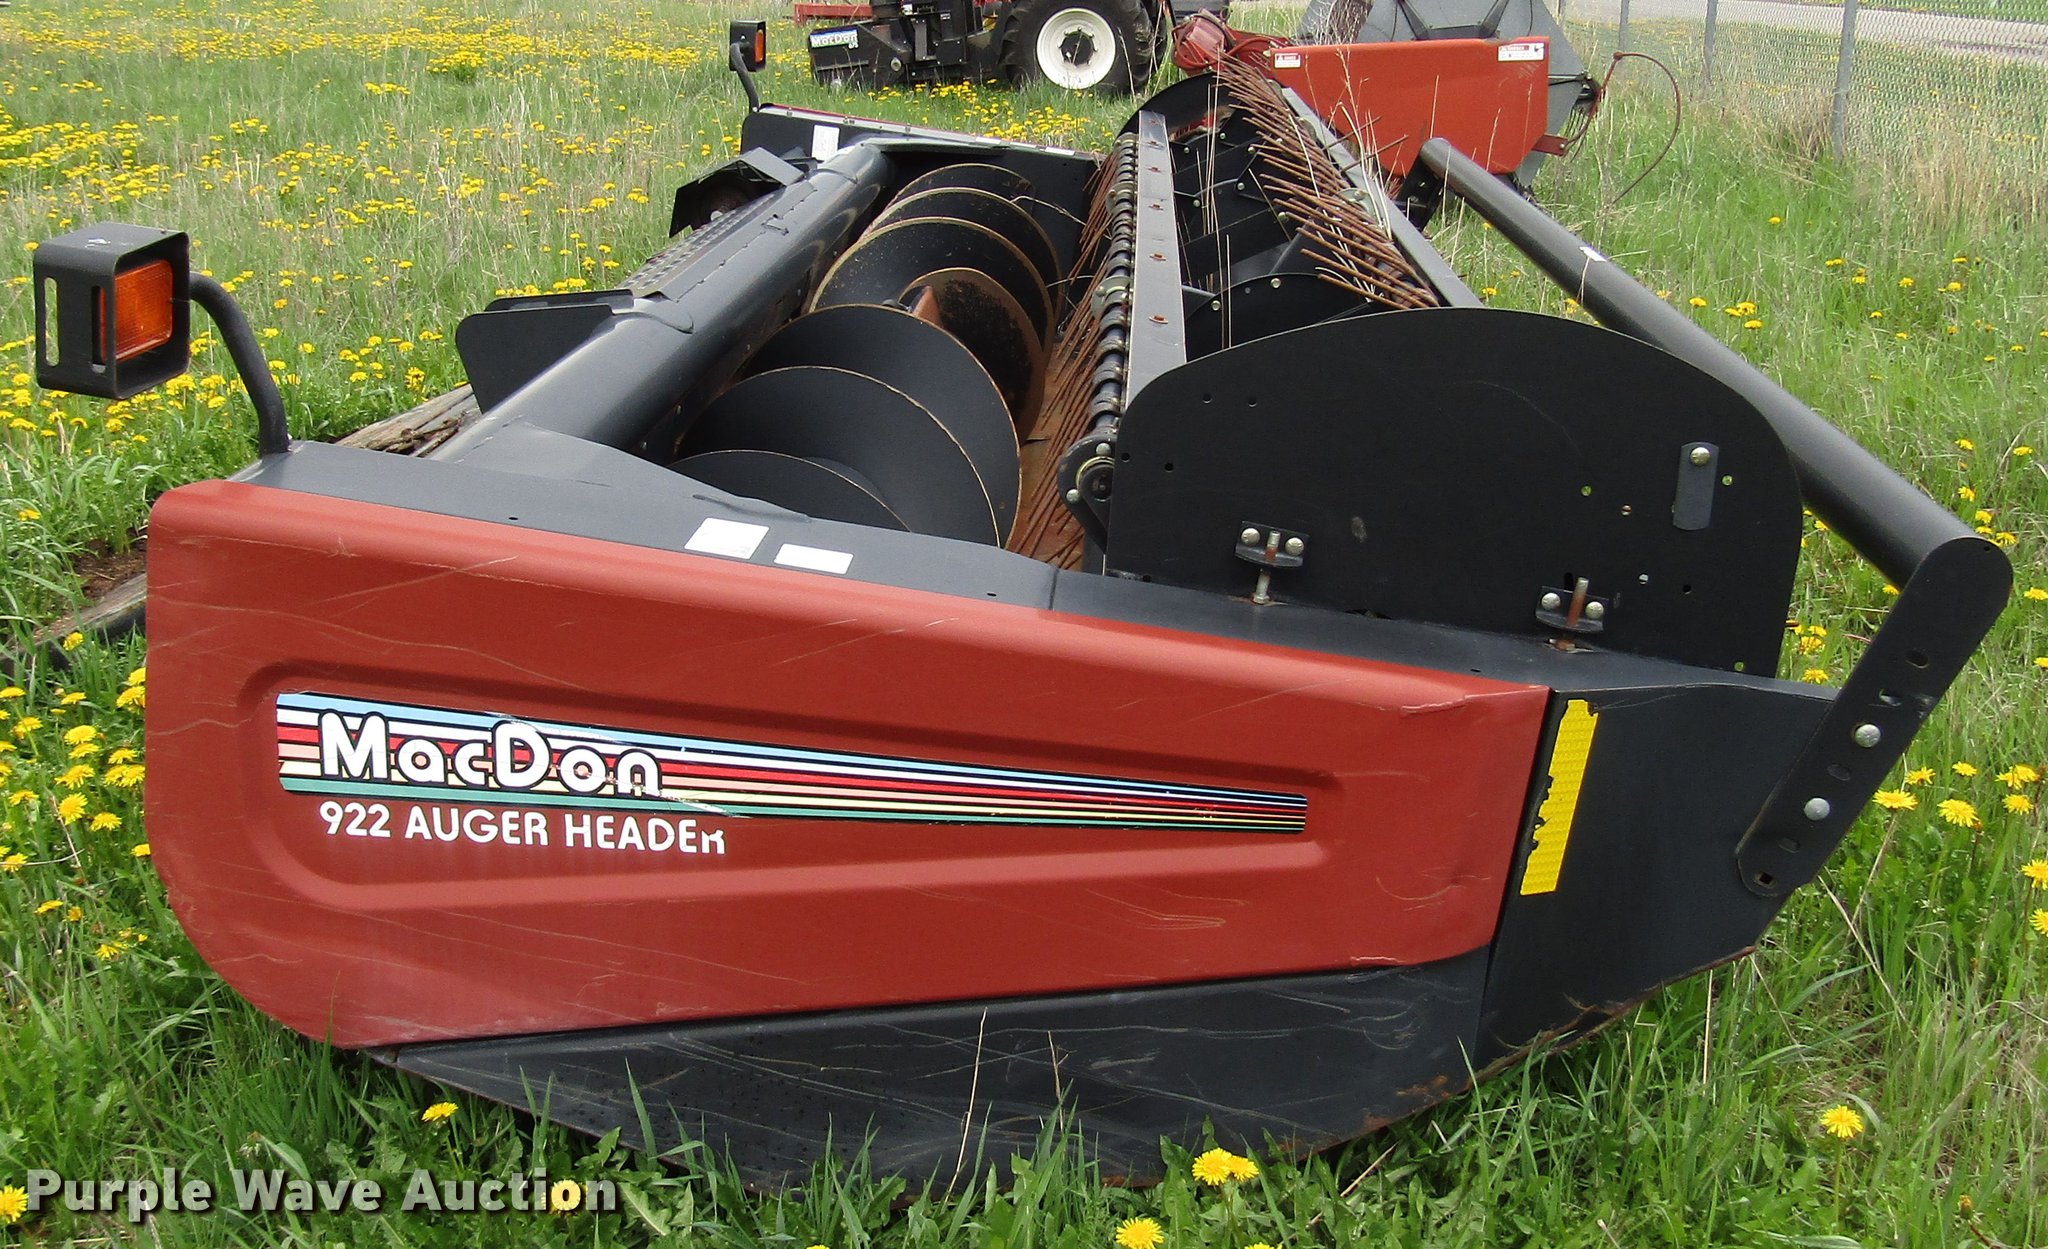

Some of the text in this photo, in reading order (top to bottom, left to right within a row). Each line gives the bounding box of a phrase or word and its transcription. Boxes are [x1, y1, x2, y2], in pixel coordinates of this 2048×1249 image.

[319, 710, 662, 797] MacDon
[319, 801, 391, 838] 922
[404, 805, 549, 846] AUGER
